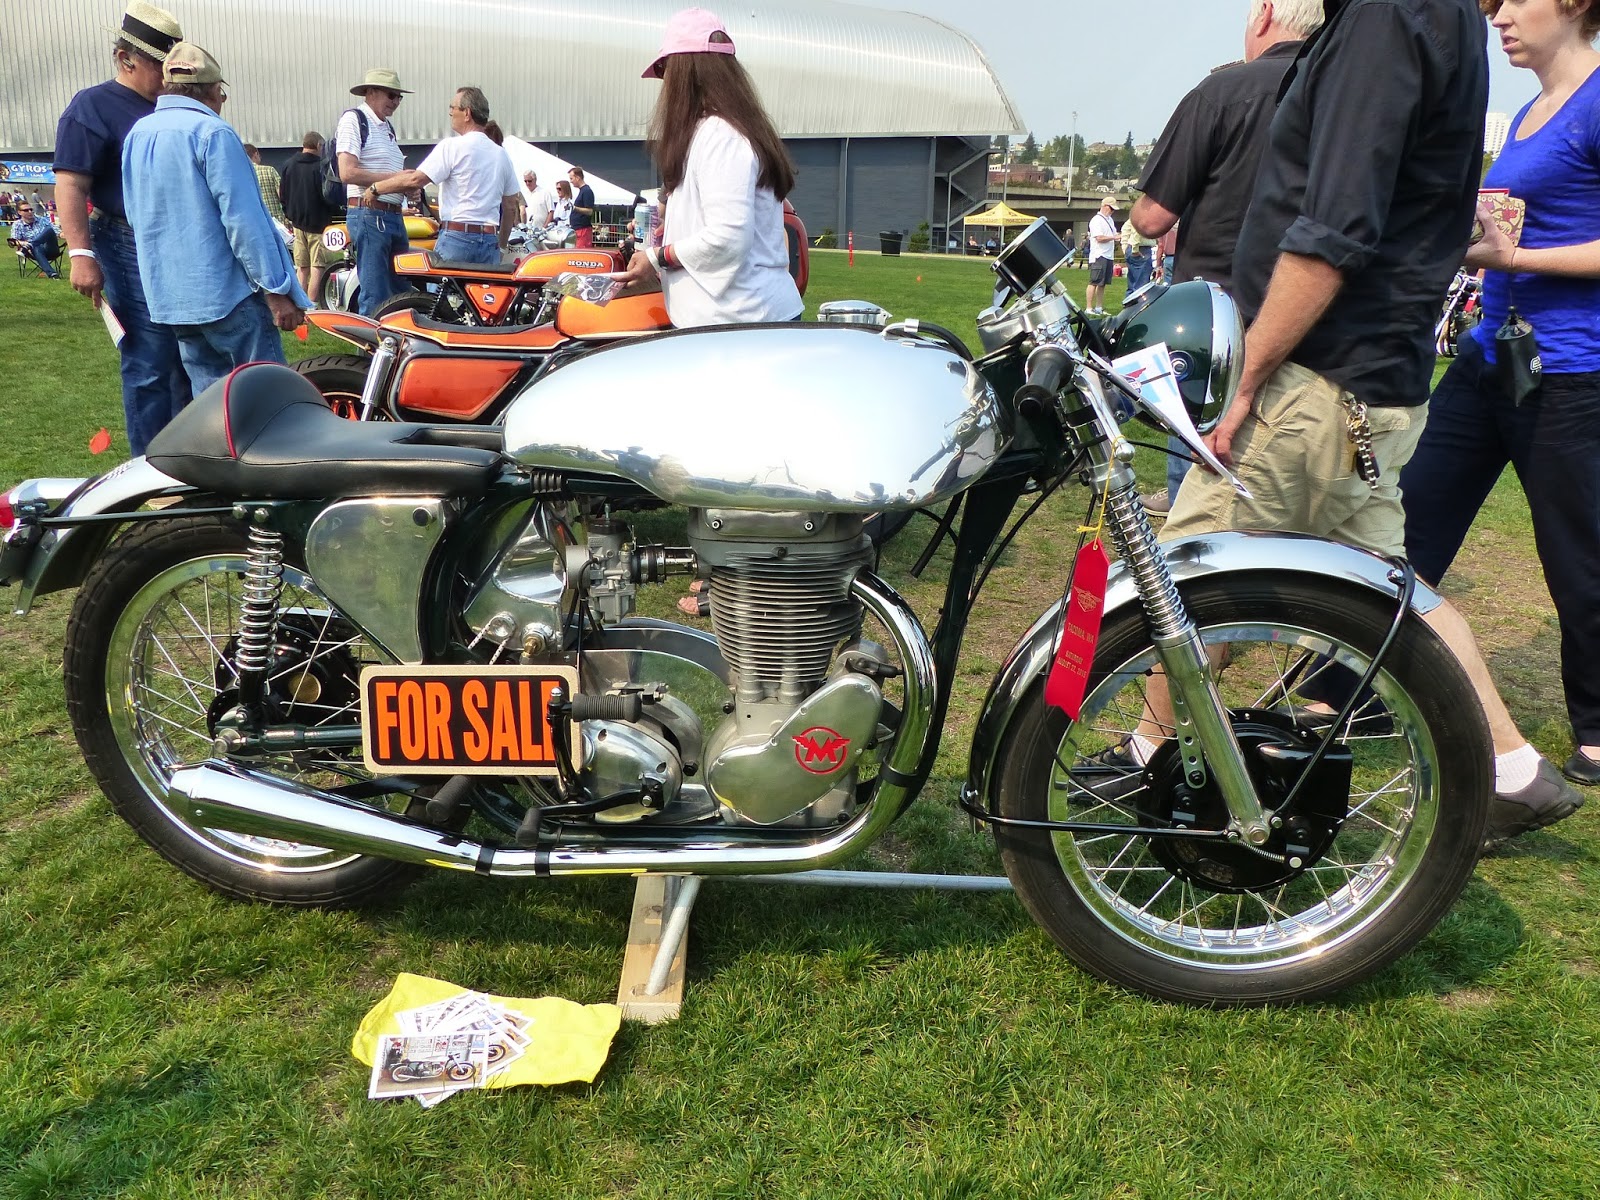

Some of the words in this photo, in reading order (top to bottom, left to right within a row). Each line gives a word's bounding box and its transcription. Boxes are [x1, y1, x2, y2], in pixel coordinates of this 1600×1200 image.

[11, 164, 47, 173] GYROS
[325, 231, 345, 247] 163
[567, 260, 605, 269] HONDA
[1056, 656, 1071, 671] AUGUST
[375, 680, 454, 761] FOR
[462, 680, 560, 762] SALE
